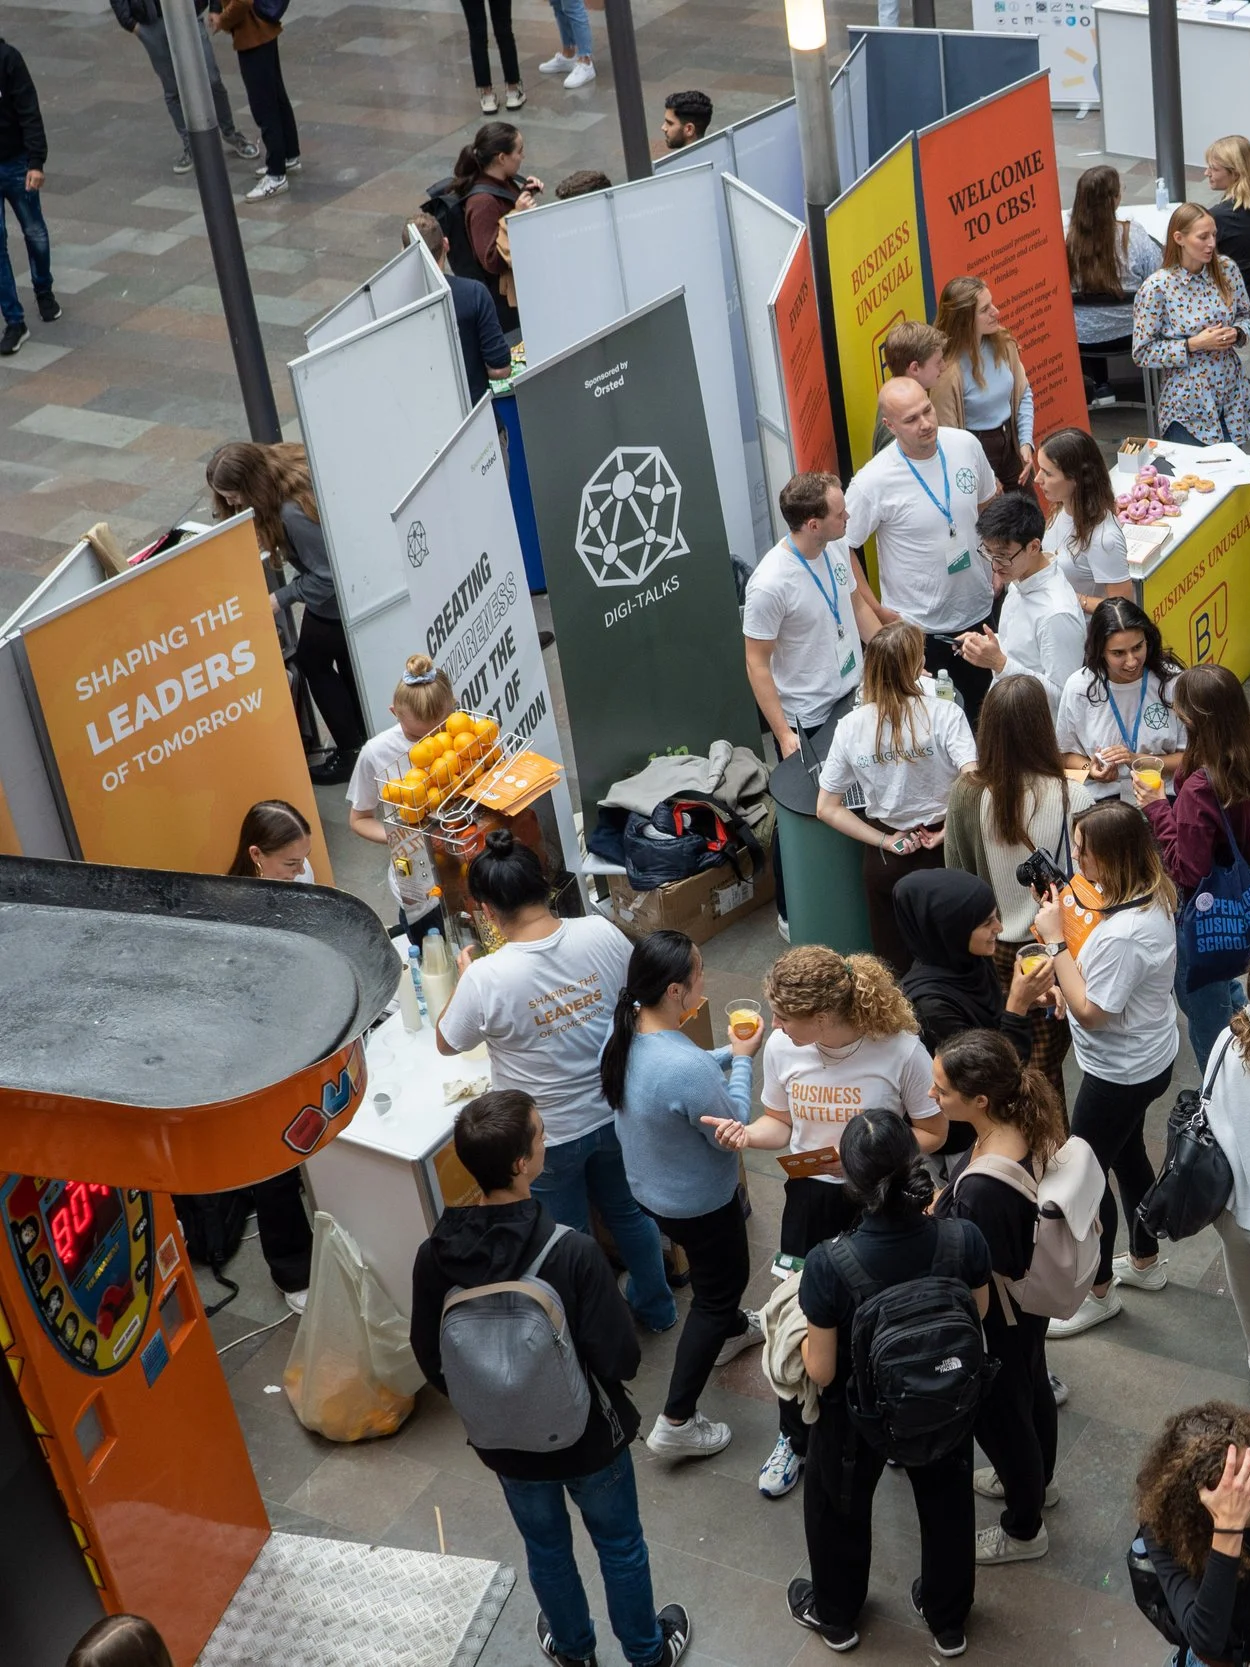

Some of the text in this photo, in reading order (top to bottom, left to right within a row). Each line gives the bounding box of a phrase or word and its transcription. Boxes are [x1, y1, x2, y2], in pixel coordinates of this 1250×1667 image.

[947, 150, 1044, 216] WELCOME
[964, 184, 1037, 242] TO CBS!
[851, 220, 910, 296] BUSINESS
[967, 227, 1040, 272] Business Unusual promotes
[1029, 235, 1049, 253] critical
[789, 279, 809, 332] EVENTS
[856, 256, 913, 327] UNUSUAL
[1011, 286, 1034, 303] business
[1035, 278, 1046, 291] and
[1035, 290, 1051, 305] range
[584, 361, 628, 389] Sponsored by
[1047, 363, 1064, 378] world
[1048, 352, 1063, 367] open
[426, 551, 492, 661] CREATING
[604, 574, 680, 628] DIGI-TALKS
[1152, 560, 1206, 625] BUSINESS
[75, 595, 243, 701] SHAPING THE
[441, 571, 518, 686] WARENESS
[489, 625, 516, 680] THE
[86, 639, 256, 756] LEADERS
[504, 668, 521, 713] OF
[101, 687, 263, 792] OF TOMORROW
[1197, 935, 1250, 953] SCHOOL
[528, 972, 600, 1010] SHAPING THE
[534, 988, 603, 1026] LEADERS
[539, 1029, 553, 1039] OF
[791, 1082, 862, 1105] BUSINESS
[135, 1217, 148, 1236] 300
